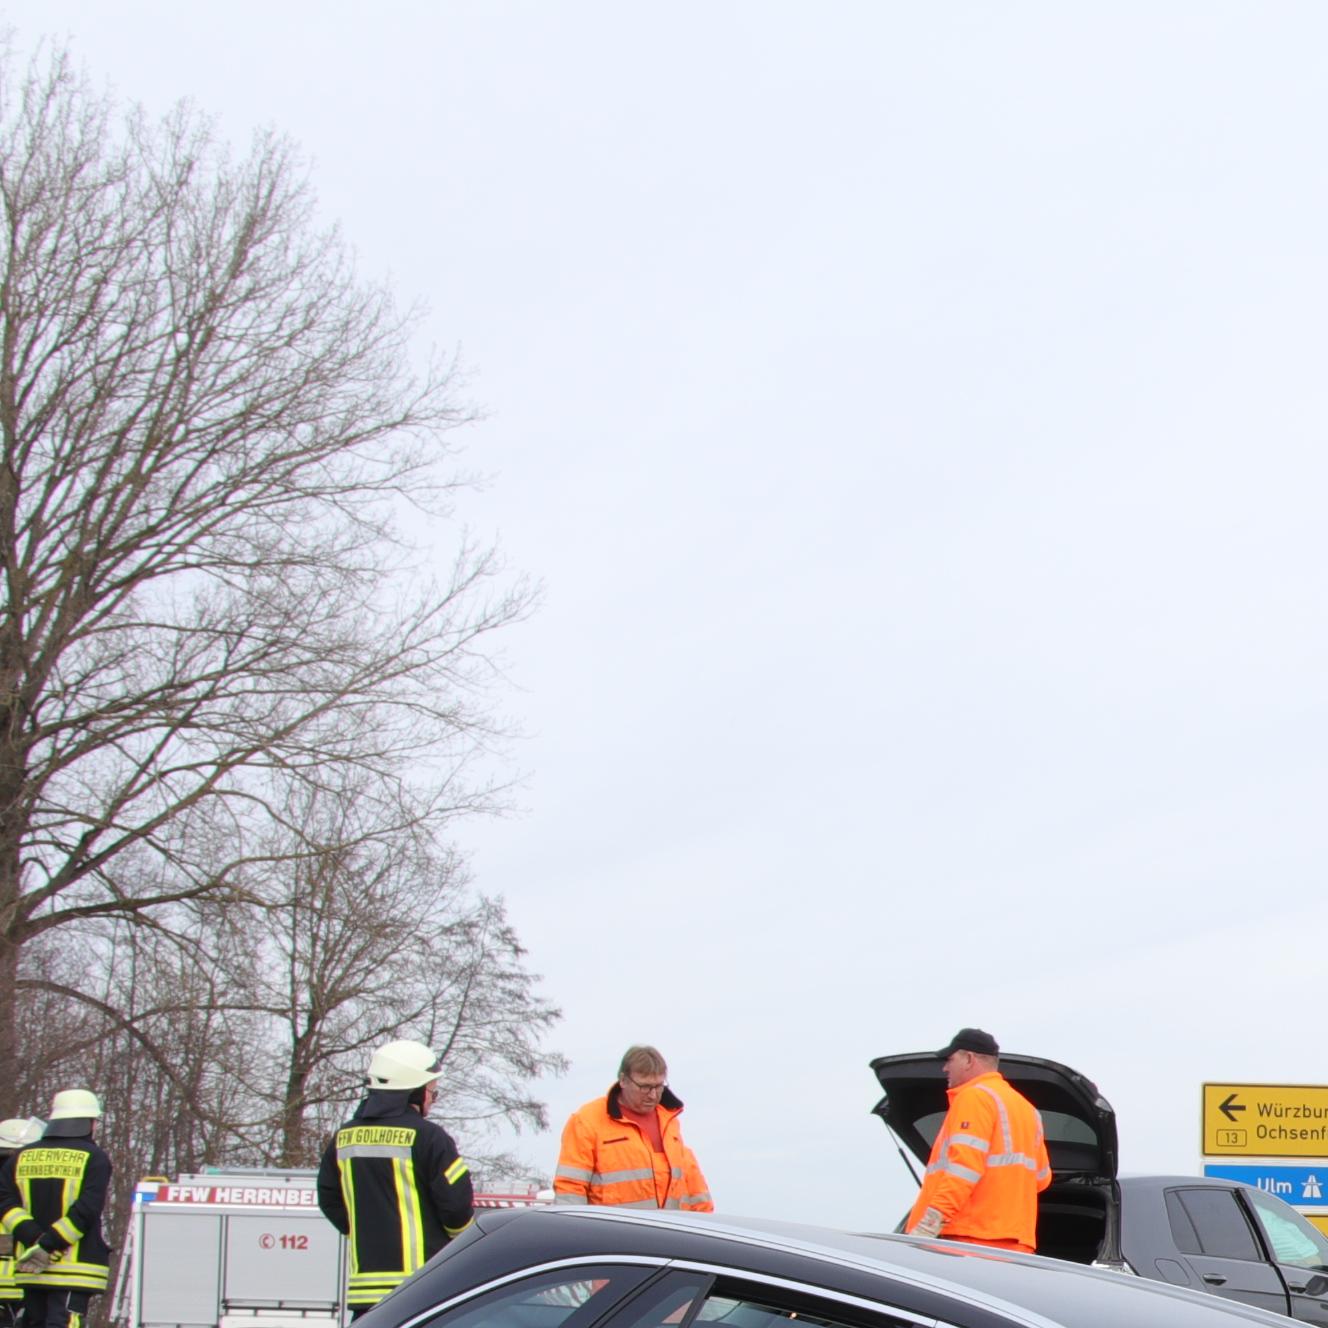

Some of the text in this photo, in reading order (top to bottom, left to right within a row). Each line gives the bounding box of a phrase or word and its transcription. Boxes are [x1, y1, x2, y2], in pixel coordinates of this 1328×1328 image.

[338, 1129, 414, 1148] FFW GOLLHOFEN
[1224, 1131, 1239, 1144] 13
[20, 1149, 86, 1164] FEUERWEHR
[1257, 1177, 1292, 1194] Ulm
[167, 1186, 212, 1203] FFW
[279, 1234, 308, 1250] 112
